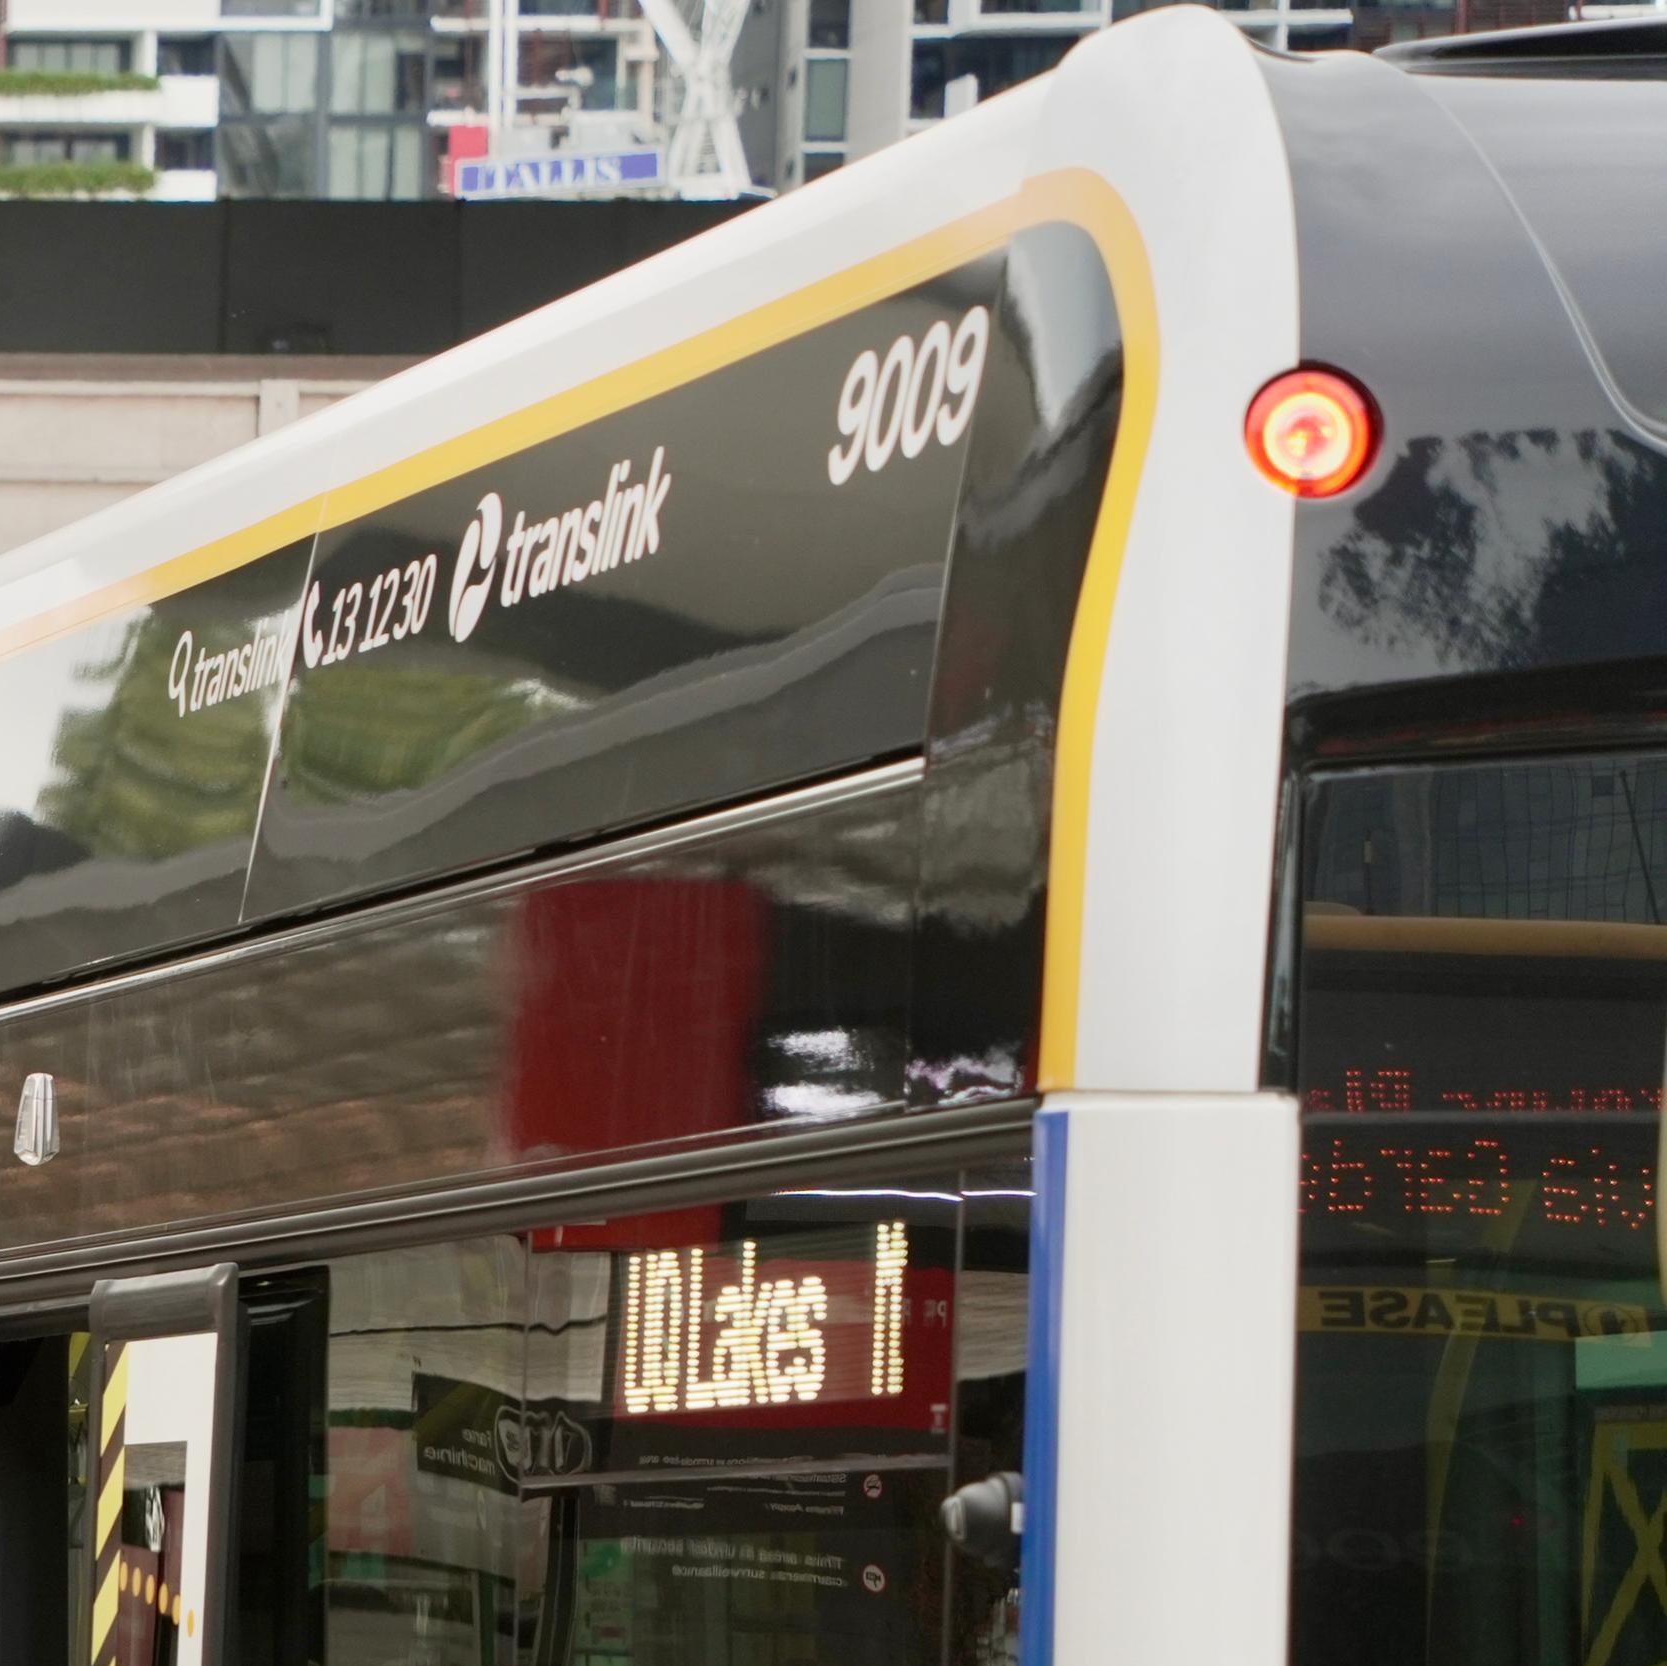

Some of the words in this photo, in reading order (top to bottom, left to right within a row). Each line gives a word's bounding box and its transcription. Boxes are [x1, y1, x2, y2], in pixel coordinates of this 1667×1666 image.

[478, 157, 622, 193] TALLIS
[828, 305, 989, 486] 9009
[500, 446, 671, 608] translink
[189, 614, 291, 712] translink
[321, 582, 363, 666] 13
